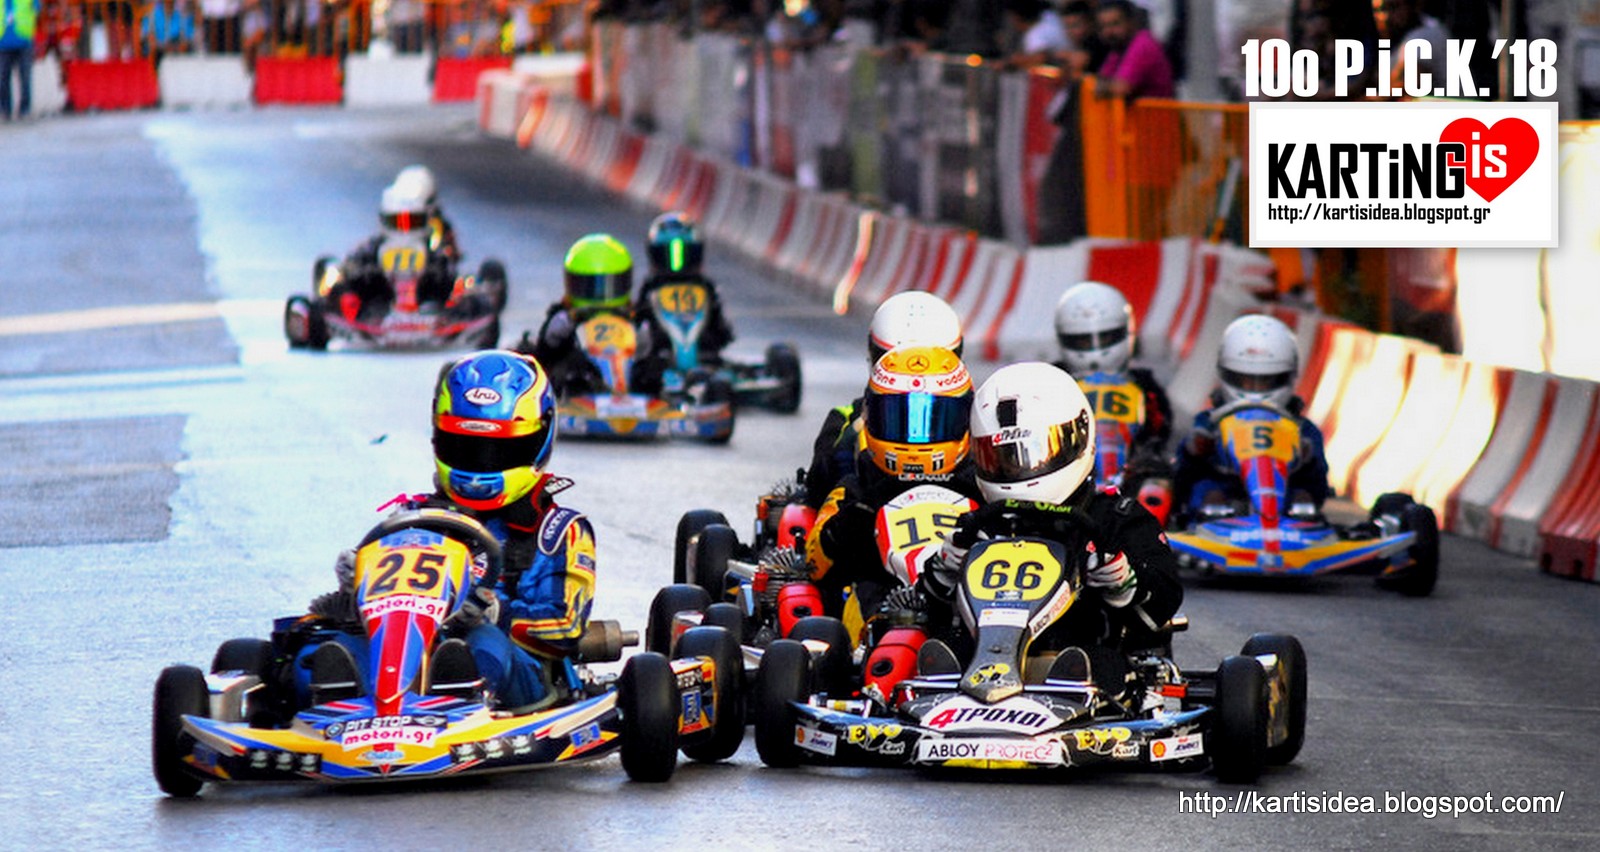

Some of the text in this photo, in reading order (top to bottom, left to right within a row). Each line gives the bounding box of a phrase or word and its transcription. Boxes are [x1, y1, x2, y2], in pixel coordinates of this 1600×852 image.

[1252, 425, 1274, 450] 5
[895, 513, 958, 550] 15
[366, 552, 447, 597] 25
[981, 560, 1044, 589] 66
[345, 715, 412, 733] PIT STOP
[344, 730, 433, 745] motori.gr
[928, 743, 980, 758] ABLOY
